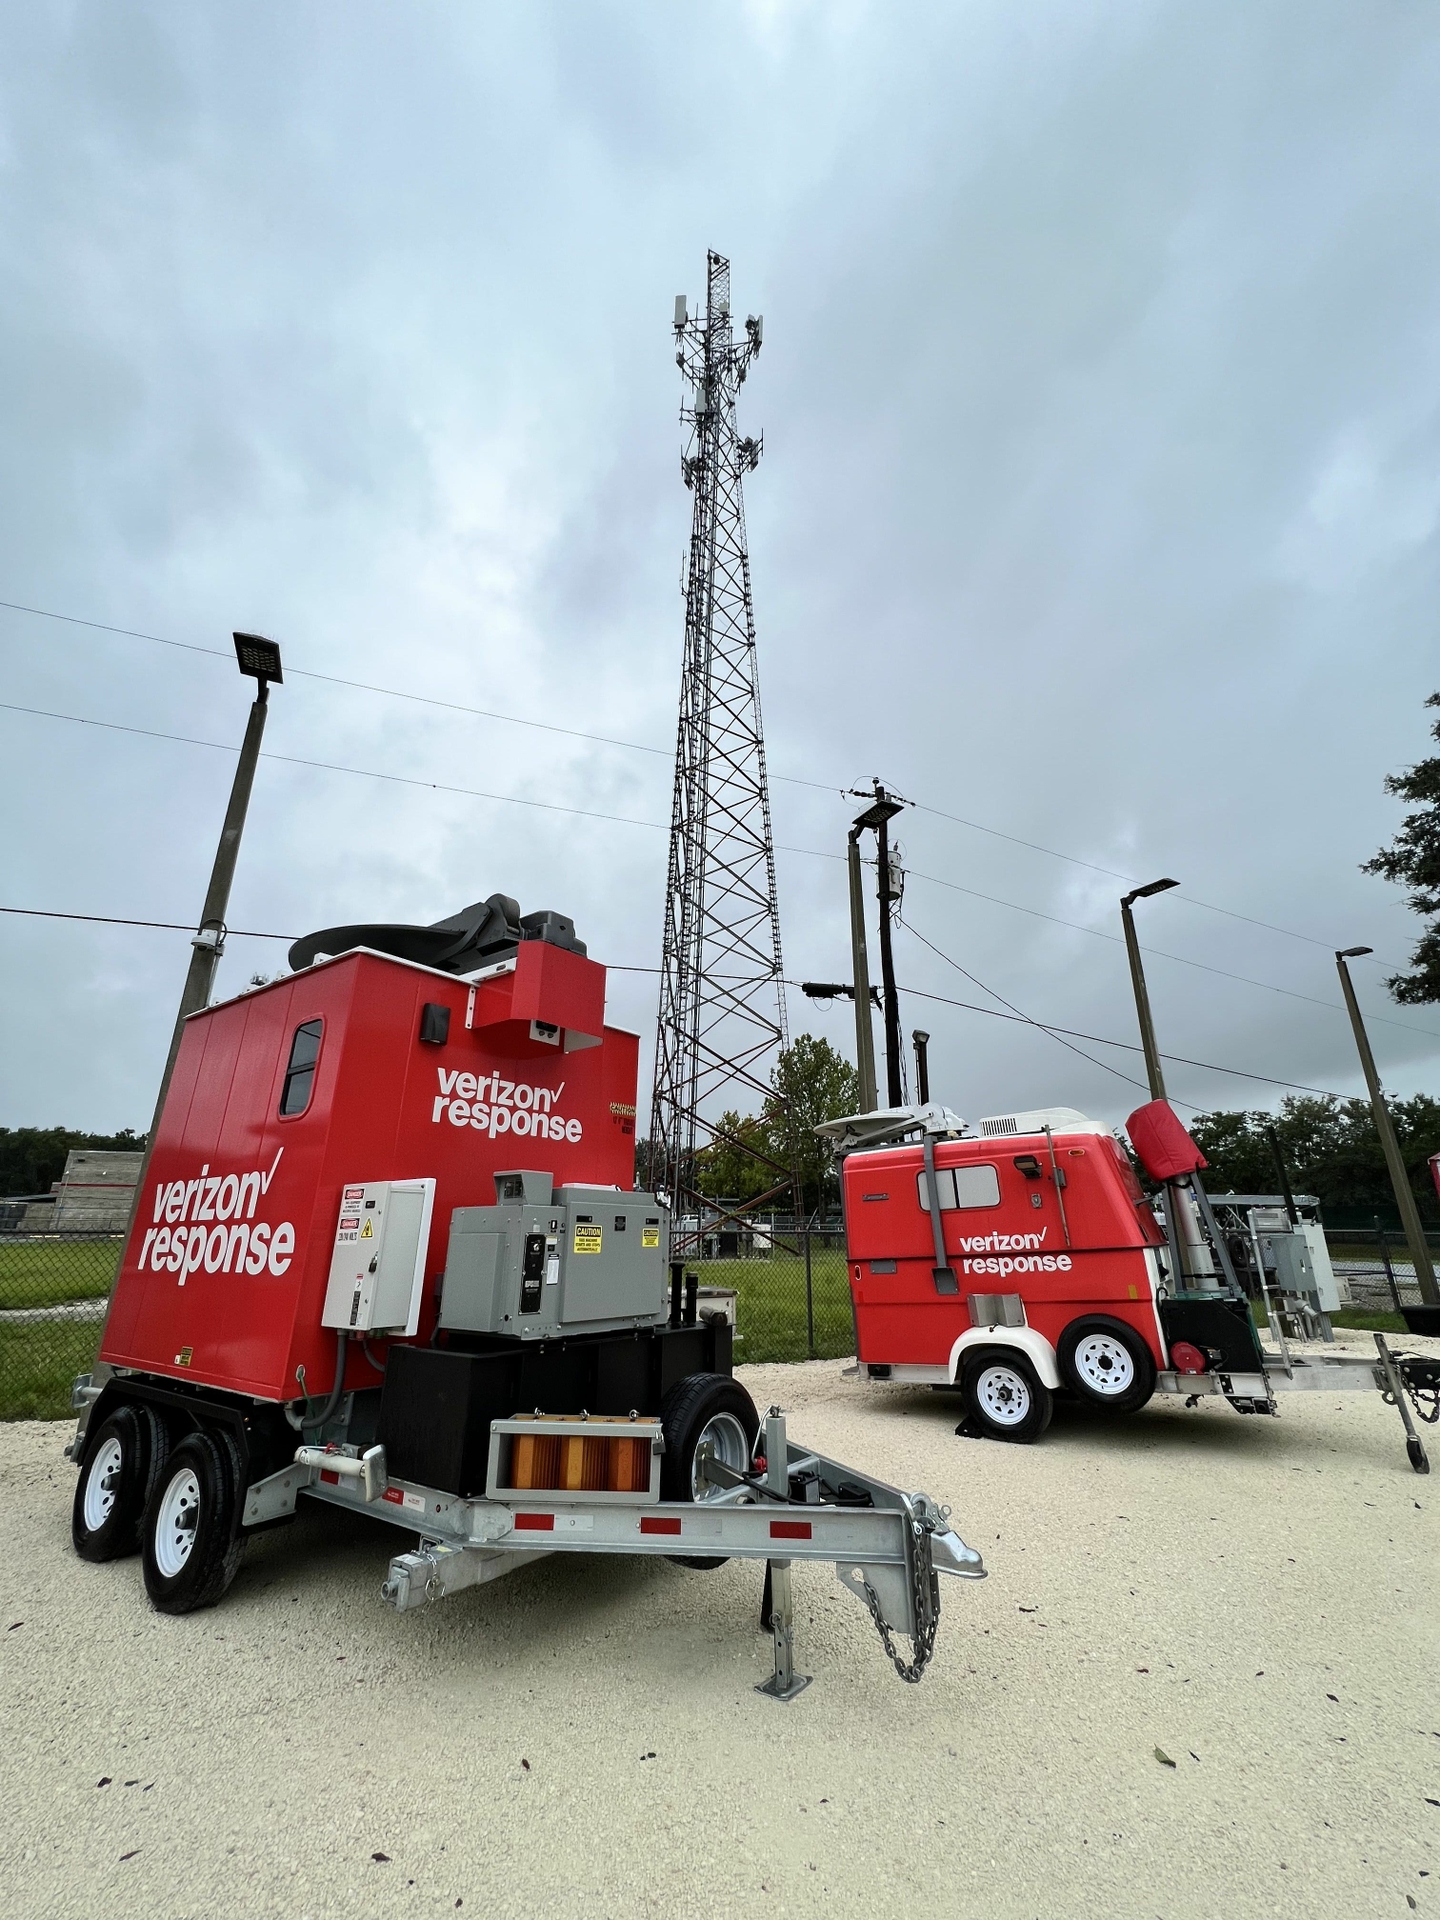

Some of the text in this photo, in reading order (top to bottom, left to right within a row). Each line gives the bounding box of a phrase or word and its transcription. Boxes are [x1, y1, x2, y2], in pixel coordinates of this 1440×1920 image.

[437, 1067, 551, 1113] verizon
[432, 1095, 583, 1143] response
[153, 1163, 261, 1223] verizon
[138, 1221, 295, 1286] response
[577, 1227, 601, 1236] CAUTION
[960, 1231, 1040, 1252] verizon
[963, 1255, 1073, 1277] response
